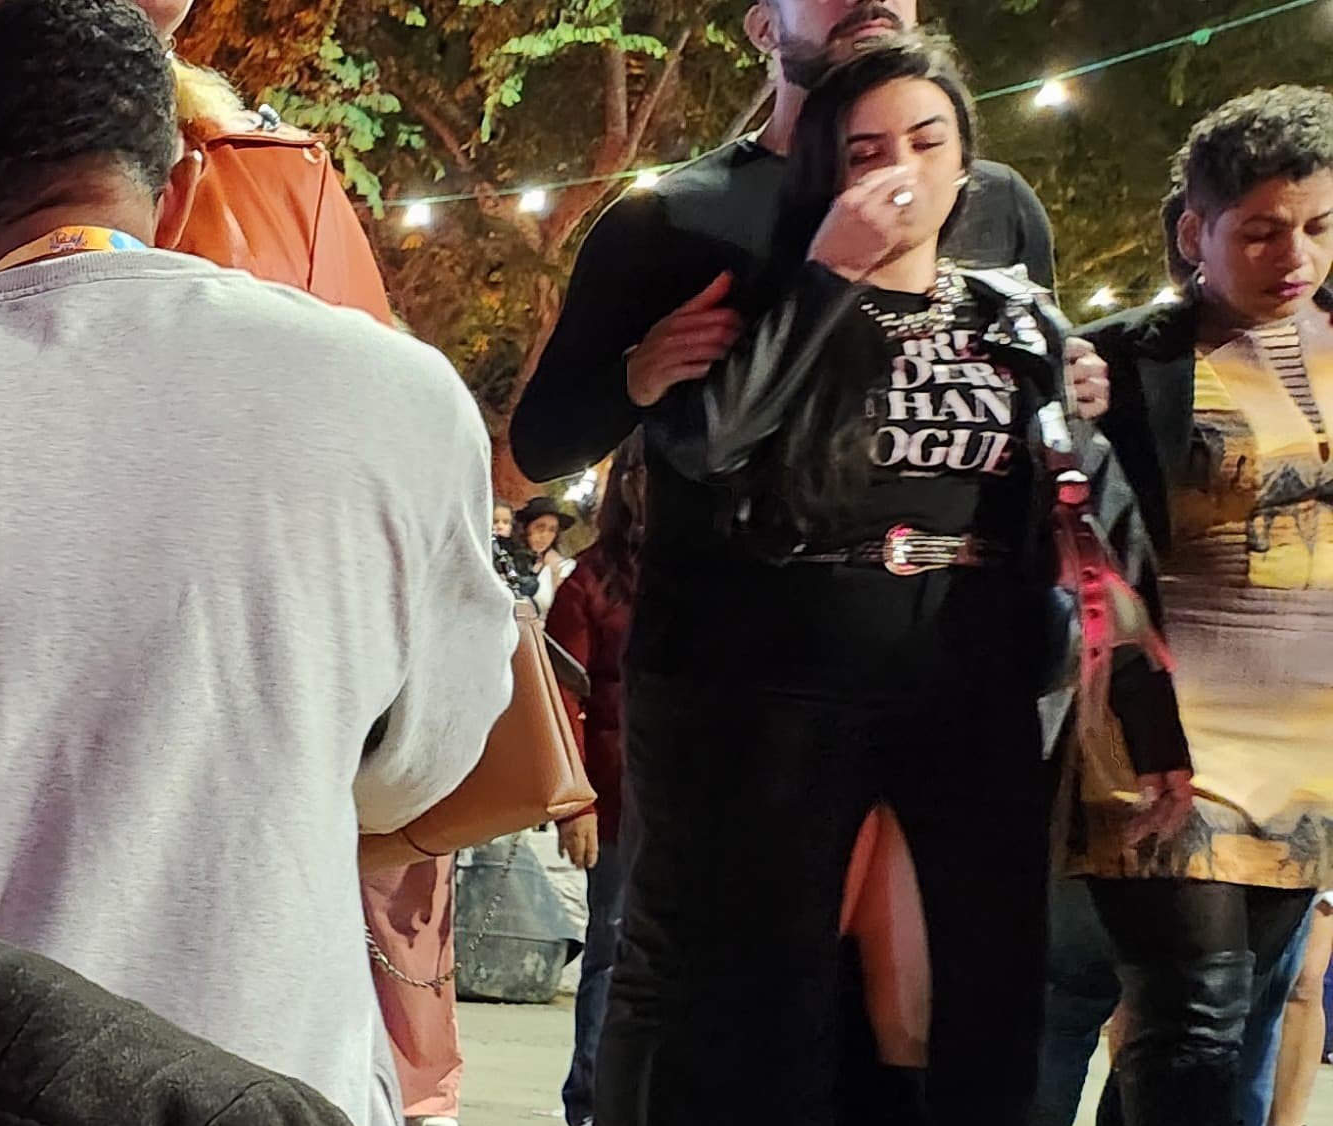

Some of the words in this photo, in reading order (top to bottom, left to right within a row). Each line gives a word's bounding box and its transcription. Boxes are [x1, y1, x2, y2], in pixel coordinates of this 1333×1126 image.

[891, 356, 1019, 389] DER
[887, 388, 1012, 426] HAN
[868, 425, 1011, 476] OGUE
